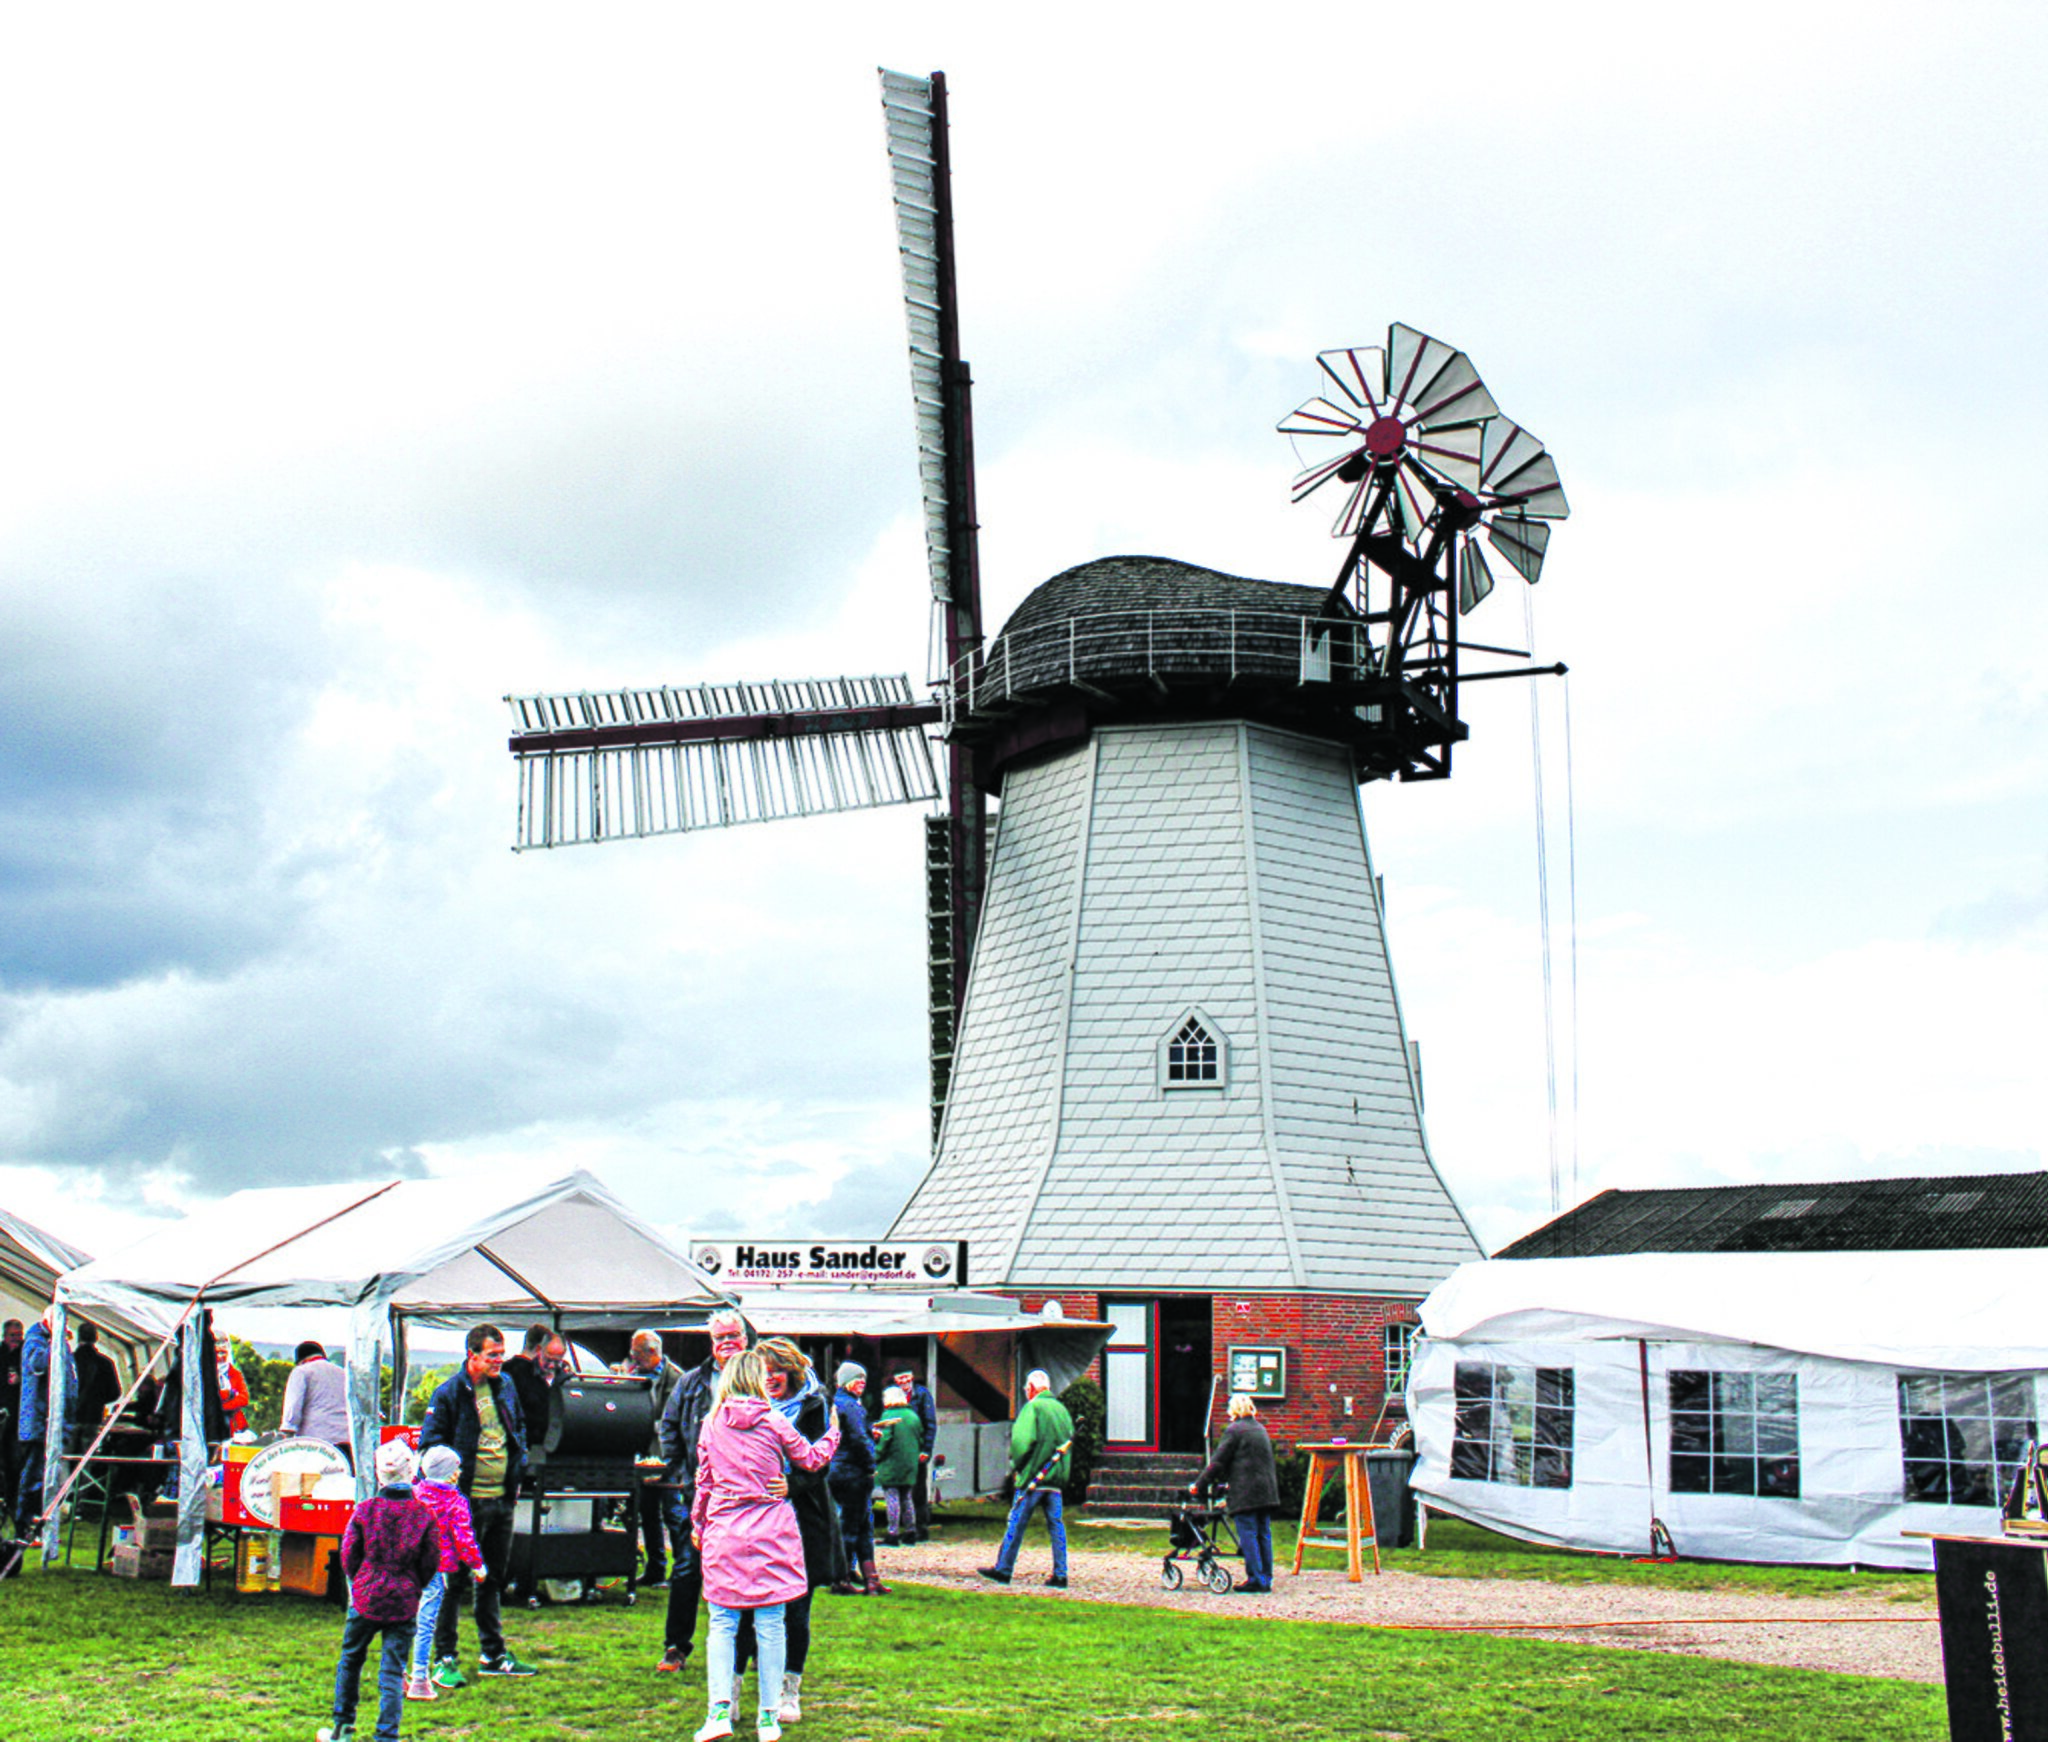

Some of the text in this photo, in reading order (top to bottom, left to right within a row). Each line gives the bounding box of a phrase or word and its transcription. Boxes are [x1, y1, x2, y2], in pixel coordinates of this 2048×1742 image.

[736, 1245, 906, 1269] Haus Sander
[777, 1269, 794, 1278] 257
[831, 1270, 917, 1280] sander@eyndorf.de
